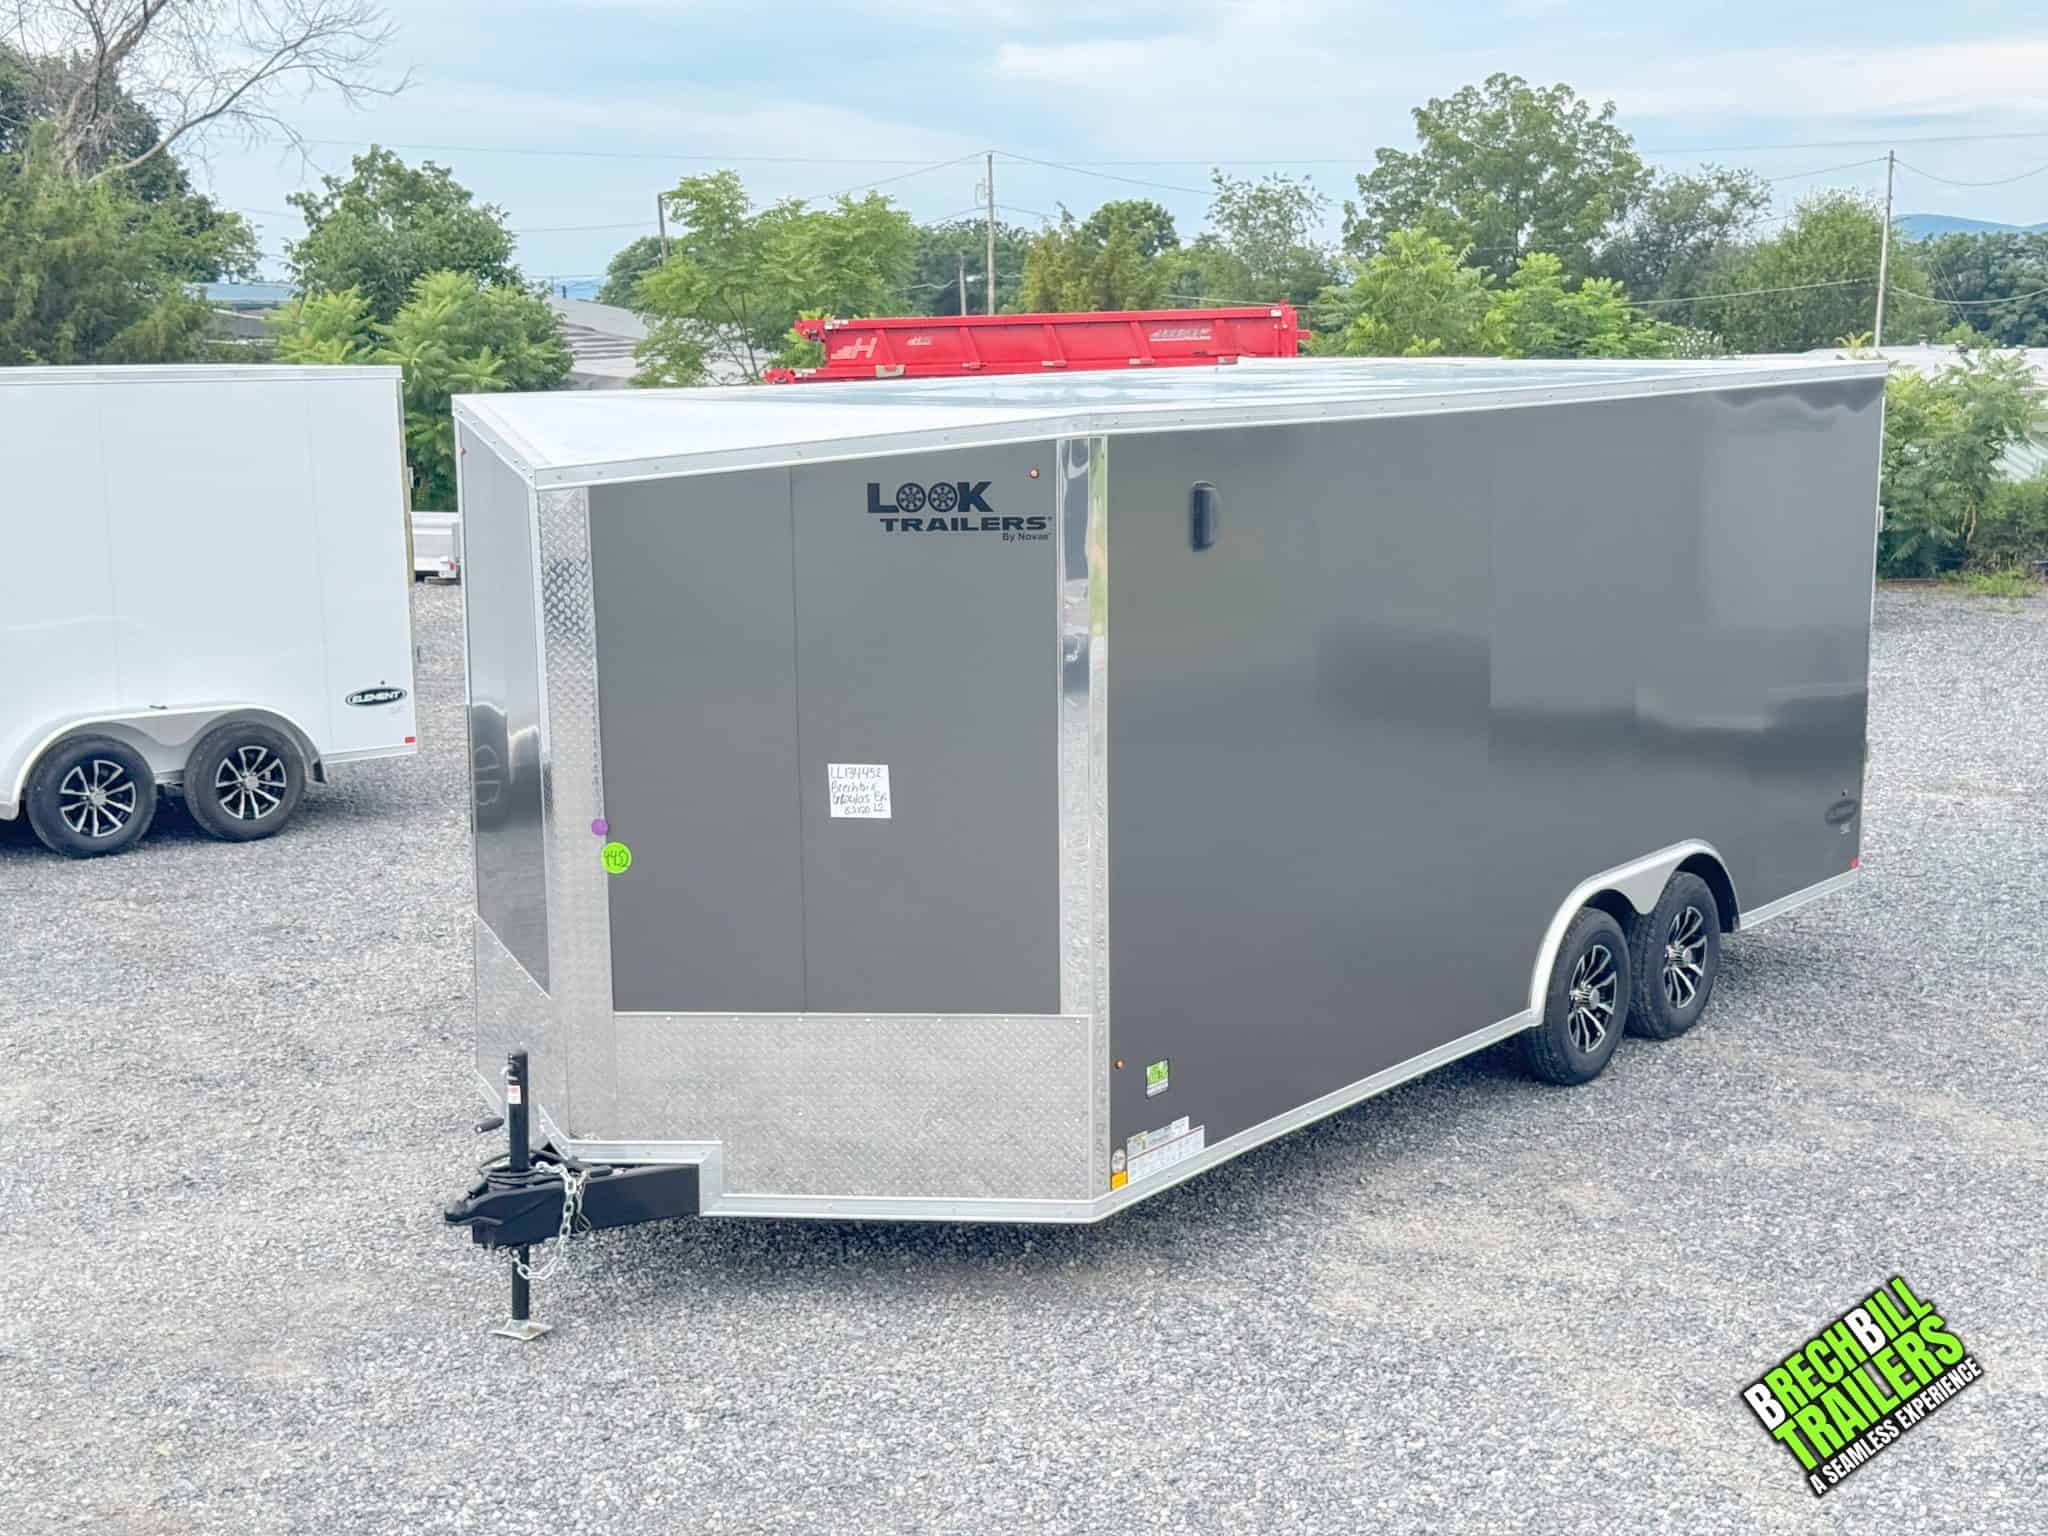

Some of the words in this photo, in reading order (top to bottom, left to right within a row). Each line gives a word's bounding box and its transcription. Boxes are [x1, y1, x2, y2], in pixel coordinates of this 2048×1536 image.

[867, 481, 994, 513] LOOK
[880, 516, 1048, 532] TRAILERS
[1002, 532, 1016, 542] By
[352, 691, 402, 703] ELEMENT
